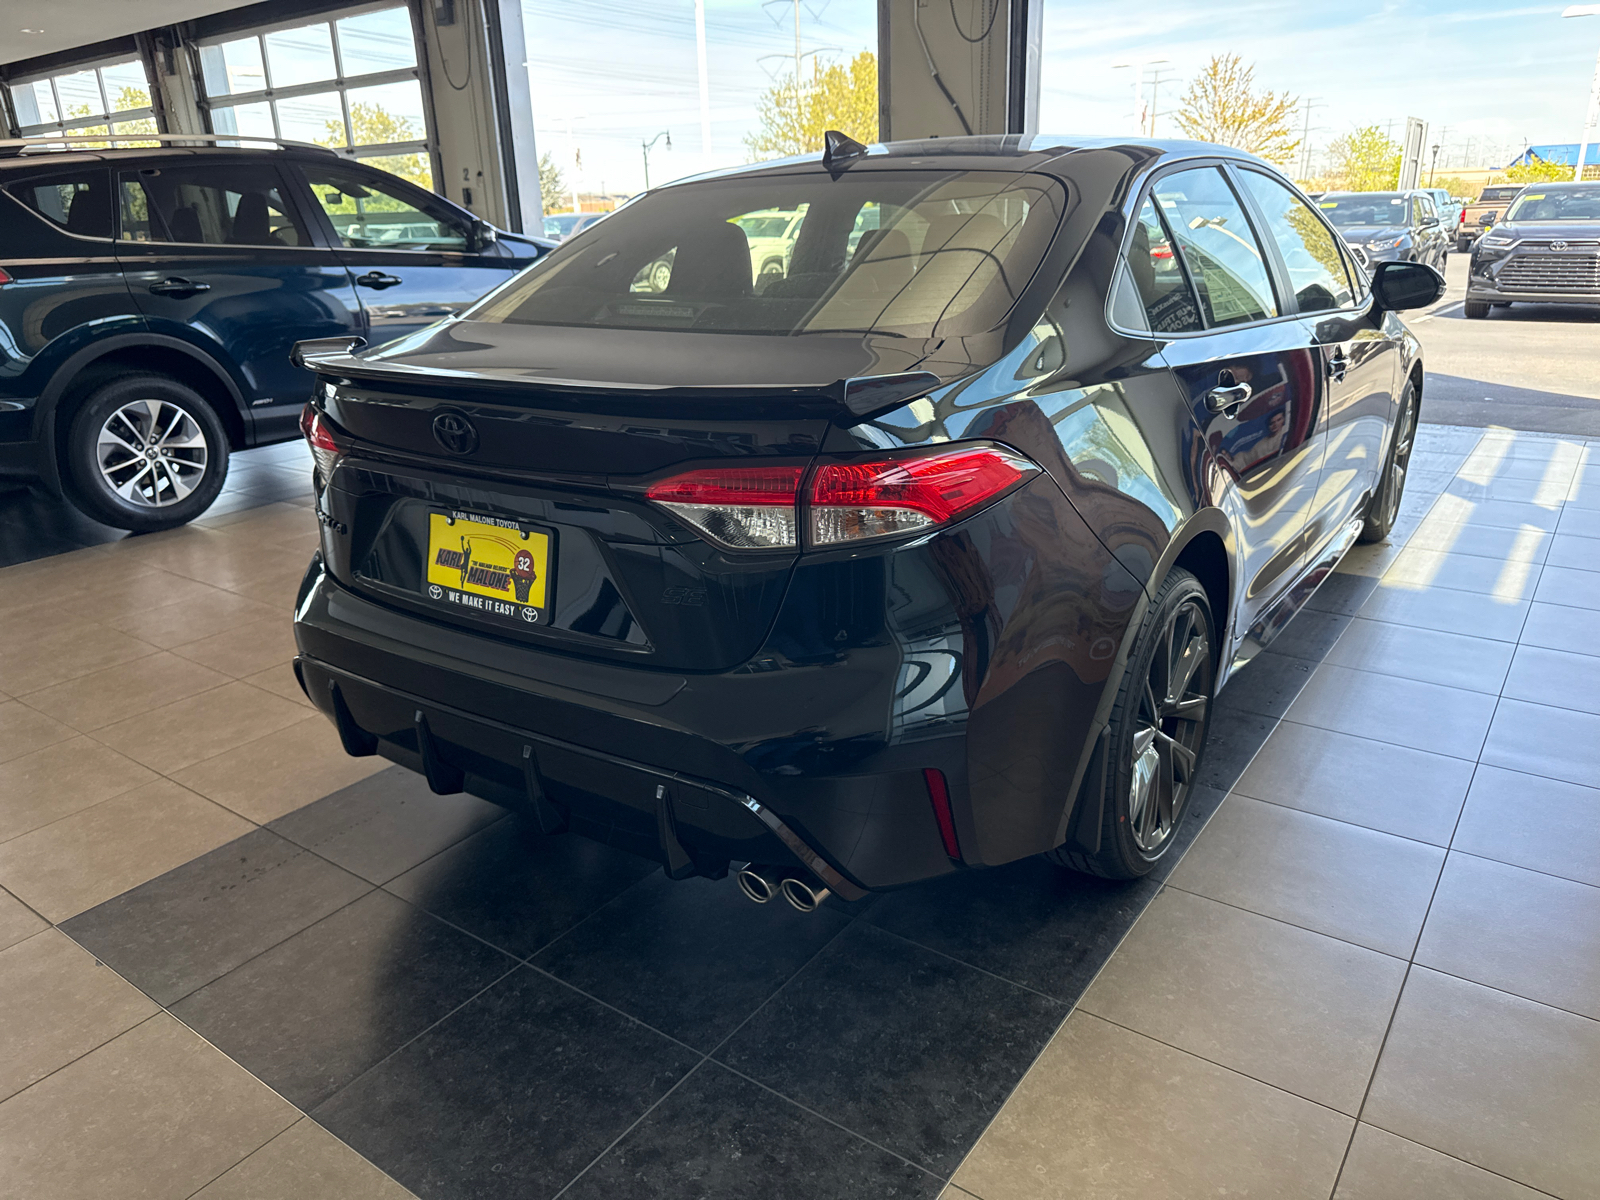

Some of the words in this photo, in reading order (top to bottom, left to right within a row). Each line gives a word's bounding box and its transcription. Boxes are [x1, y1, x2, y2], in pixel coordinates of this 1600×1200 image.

[463, 168, 470, 181] 2
[452, 511, 469, 521] KARL
[470, 514, 495, 526] MALONE
[496, 519, 520, 530] TOYOTA
[435, 548, 464, 570] KARL
[517, 556, 530, 572] 32
[467, 566, 511, 592] MALONE
[448, 591, 460, 602] WE
[462, 594, 483, 609] MAKE
[485, 600, 493, 611] IT
[495, 602, 515, 616] EASY
